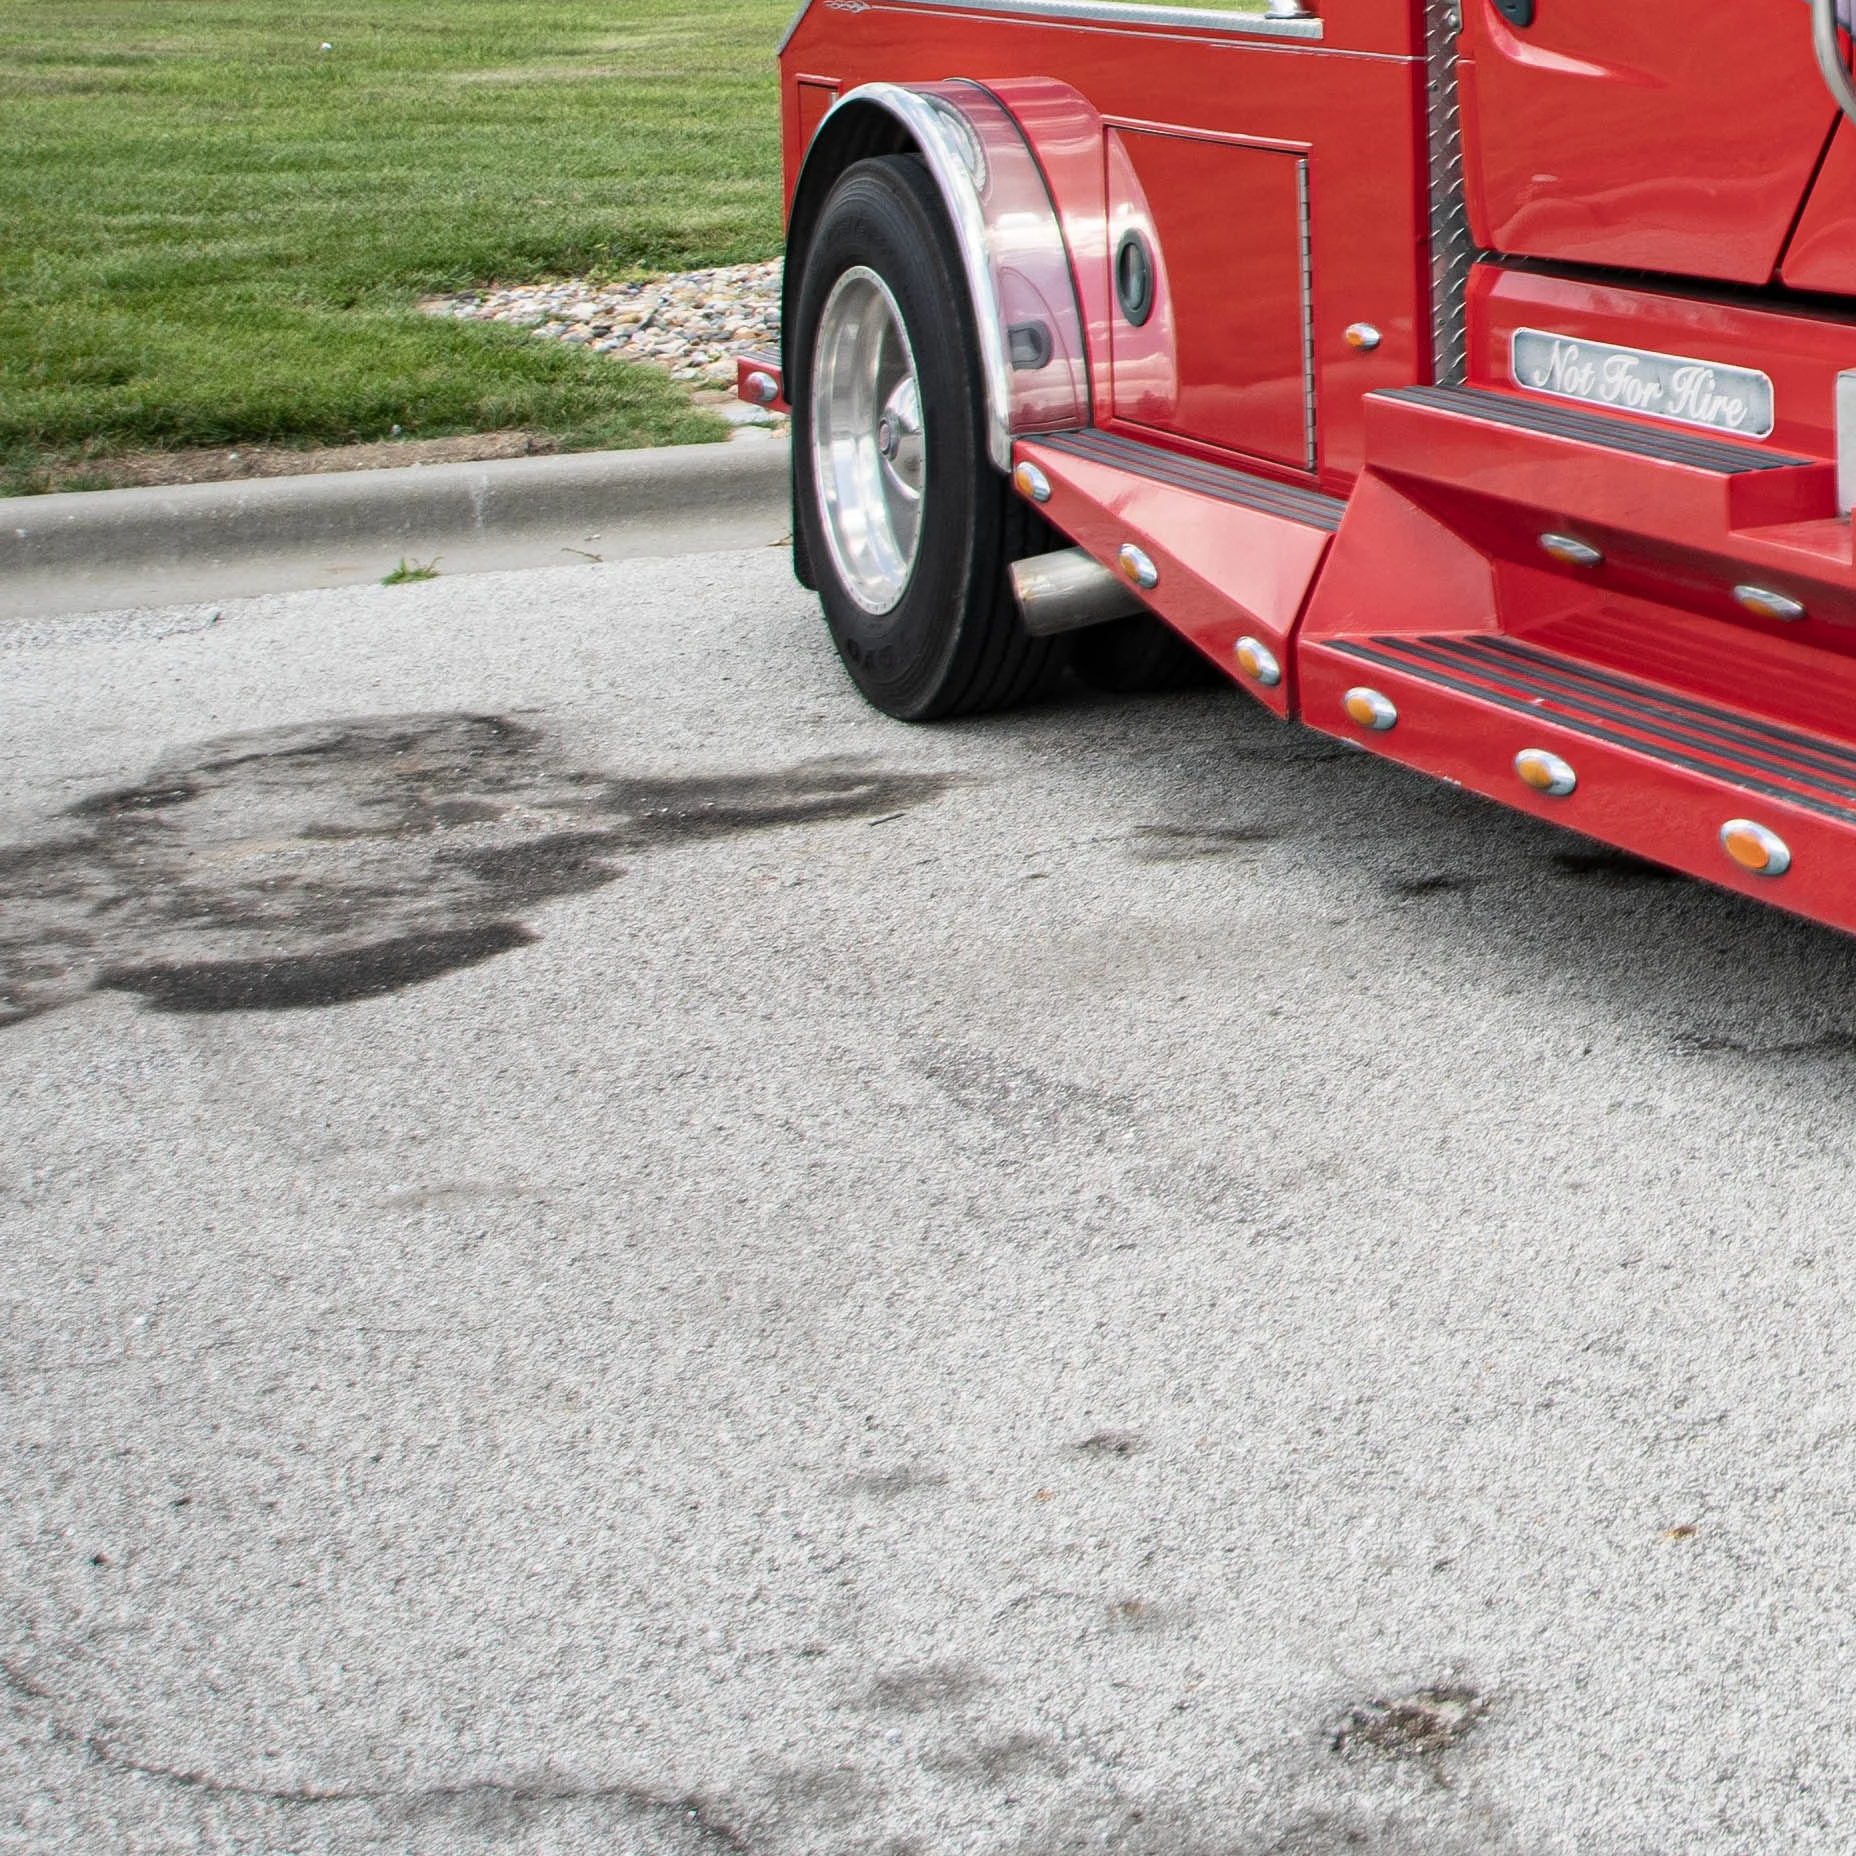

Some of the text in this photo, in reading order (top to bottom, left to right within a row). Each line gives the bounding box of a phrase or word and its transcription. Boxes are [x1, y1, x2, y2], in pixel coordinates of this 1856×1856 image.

[1533, 340, 1748, 428] Not For Hire
